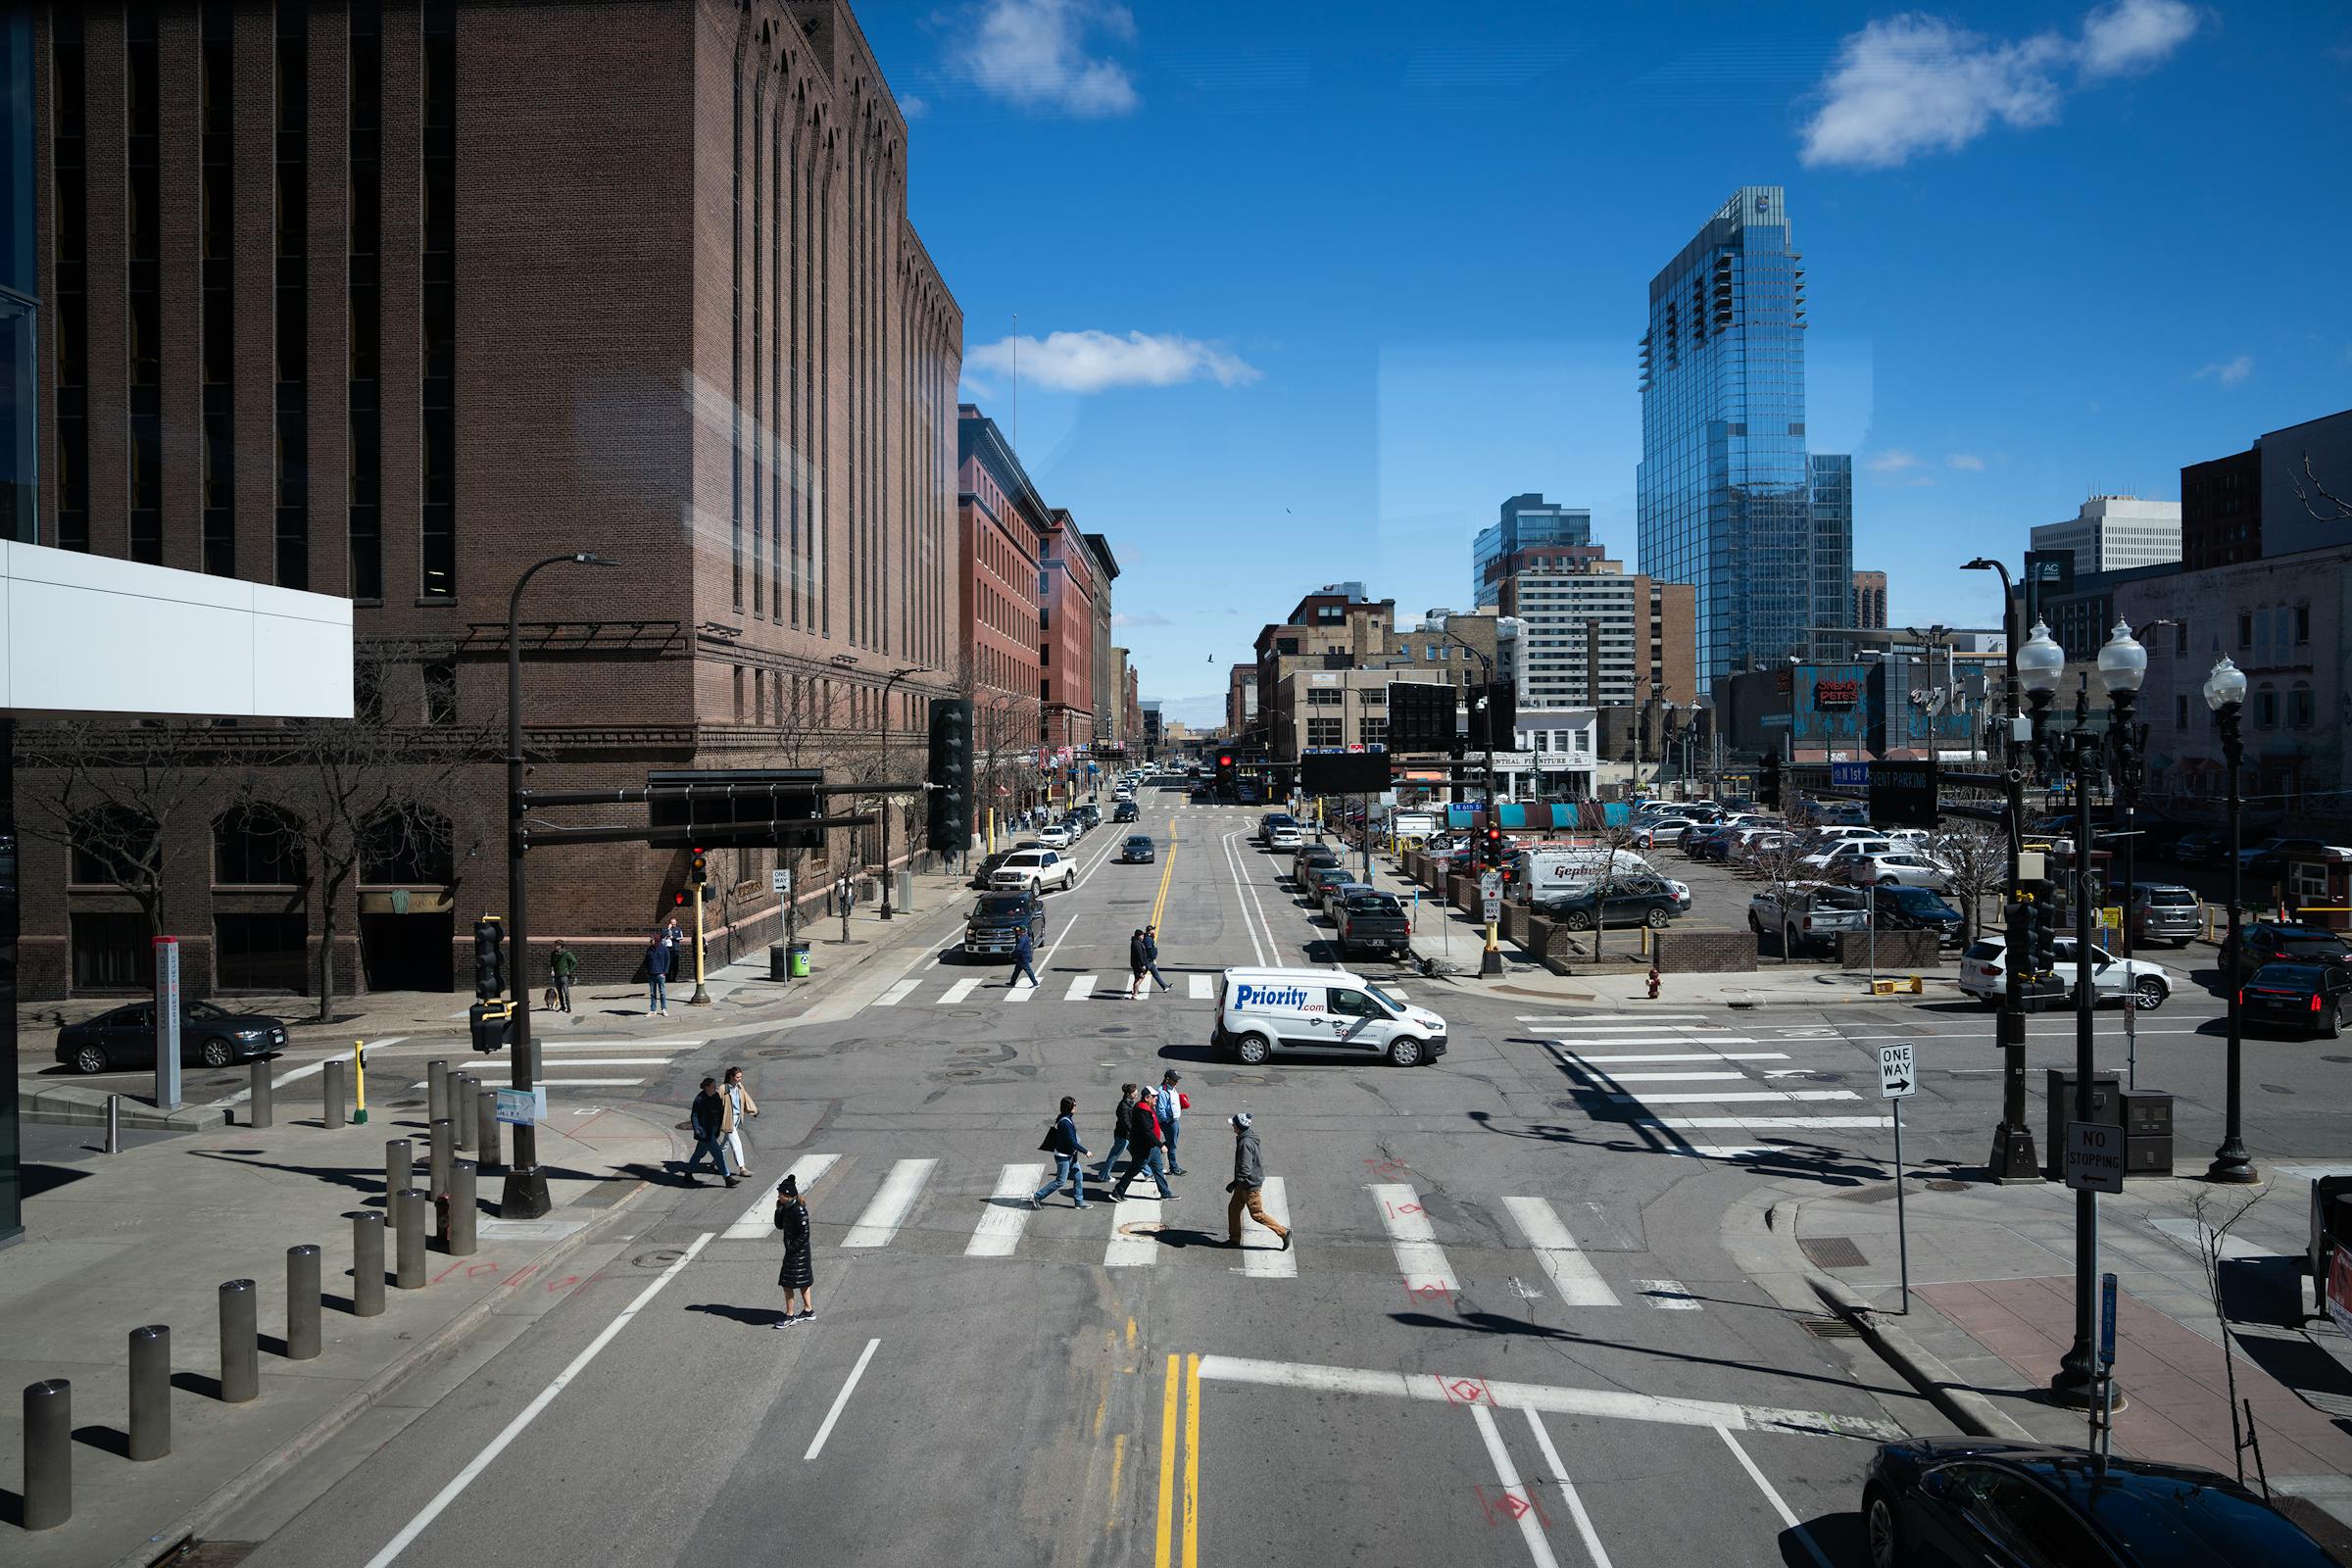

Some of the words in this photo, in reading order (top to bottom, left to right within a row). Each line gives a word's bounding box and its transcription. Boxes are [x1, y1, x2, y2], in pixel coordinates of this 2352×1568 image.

[1820, 691, 1858, 701] PETE'S
[1842, 767, 1847, 780] N
[1850, 767, 1861, 780] 1st
[1869, 771, 1890, 787] EVENT
[1892, 772, 1927, 789] PARKING
[1884, 1048, 1910, 1062] ONE
[1884, 1062, 1911, 1077] WAY
[2083, 1131, 2105, 1148] NO
[2070, 1152, 2119, 1169] STOPPING
